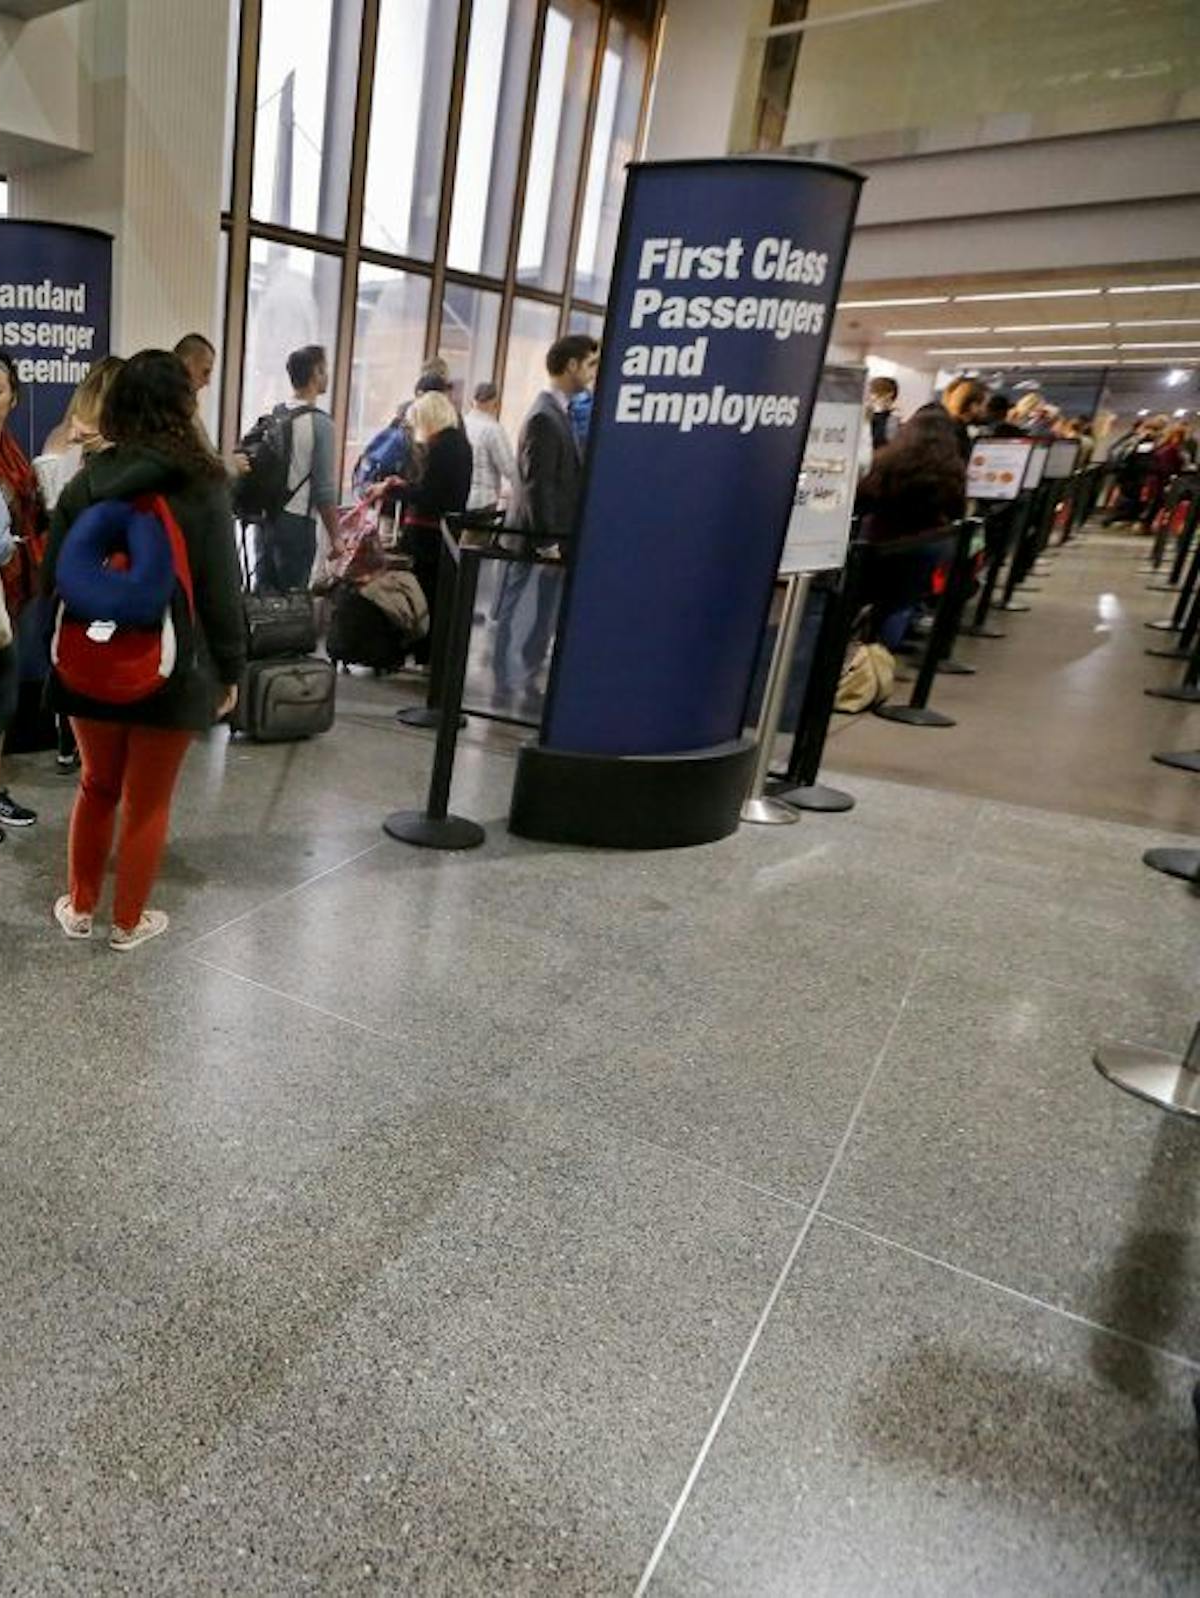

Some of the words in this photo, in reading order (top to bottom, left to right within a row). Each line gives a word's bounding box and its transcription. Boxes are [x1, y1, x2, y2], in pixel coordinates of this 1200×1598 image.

[638, 237, 744, 280] First
[752, 237, 828, 286] Class
[629, 289, 825, 340] Passengers
[622, 336, 708, 376] and
[615, 384, 798, 433] Employees
